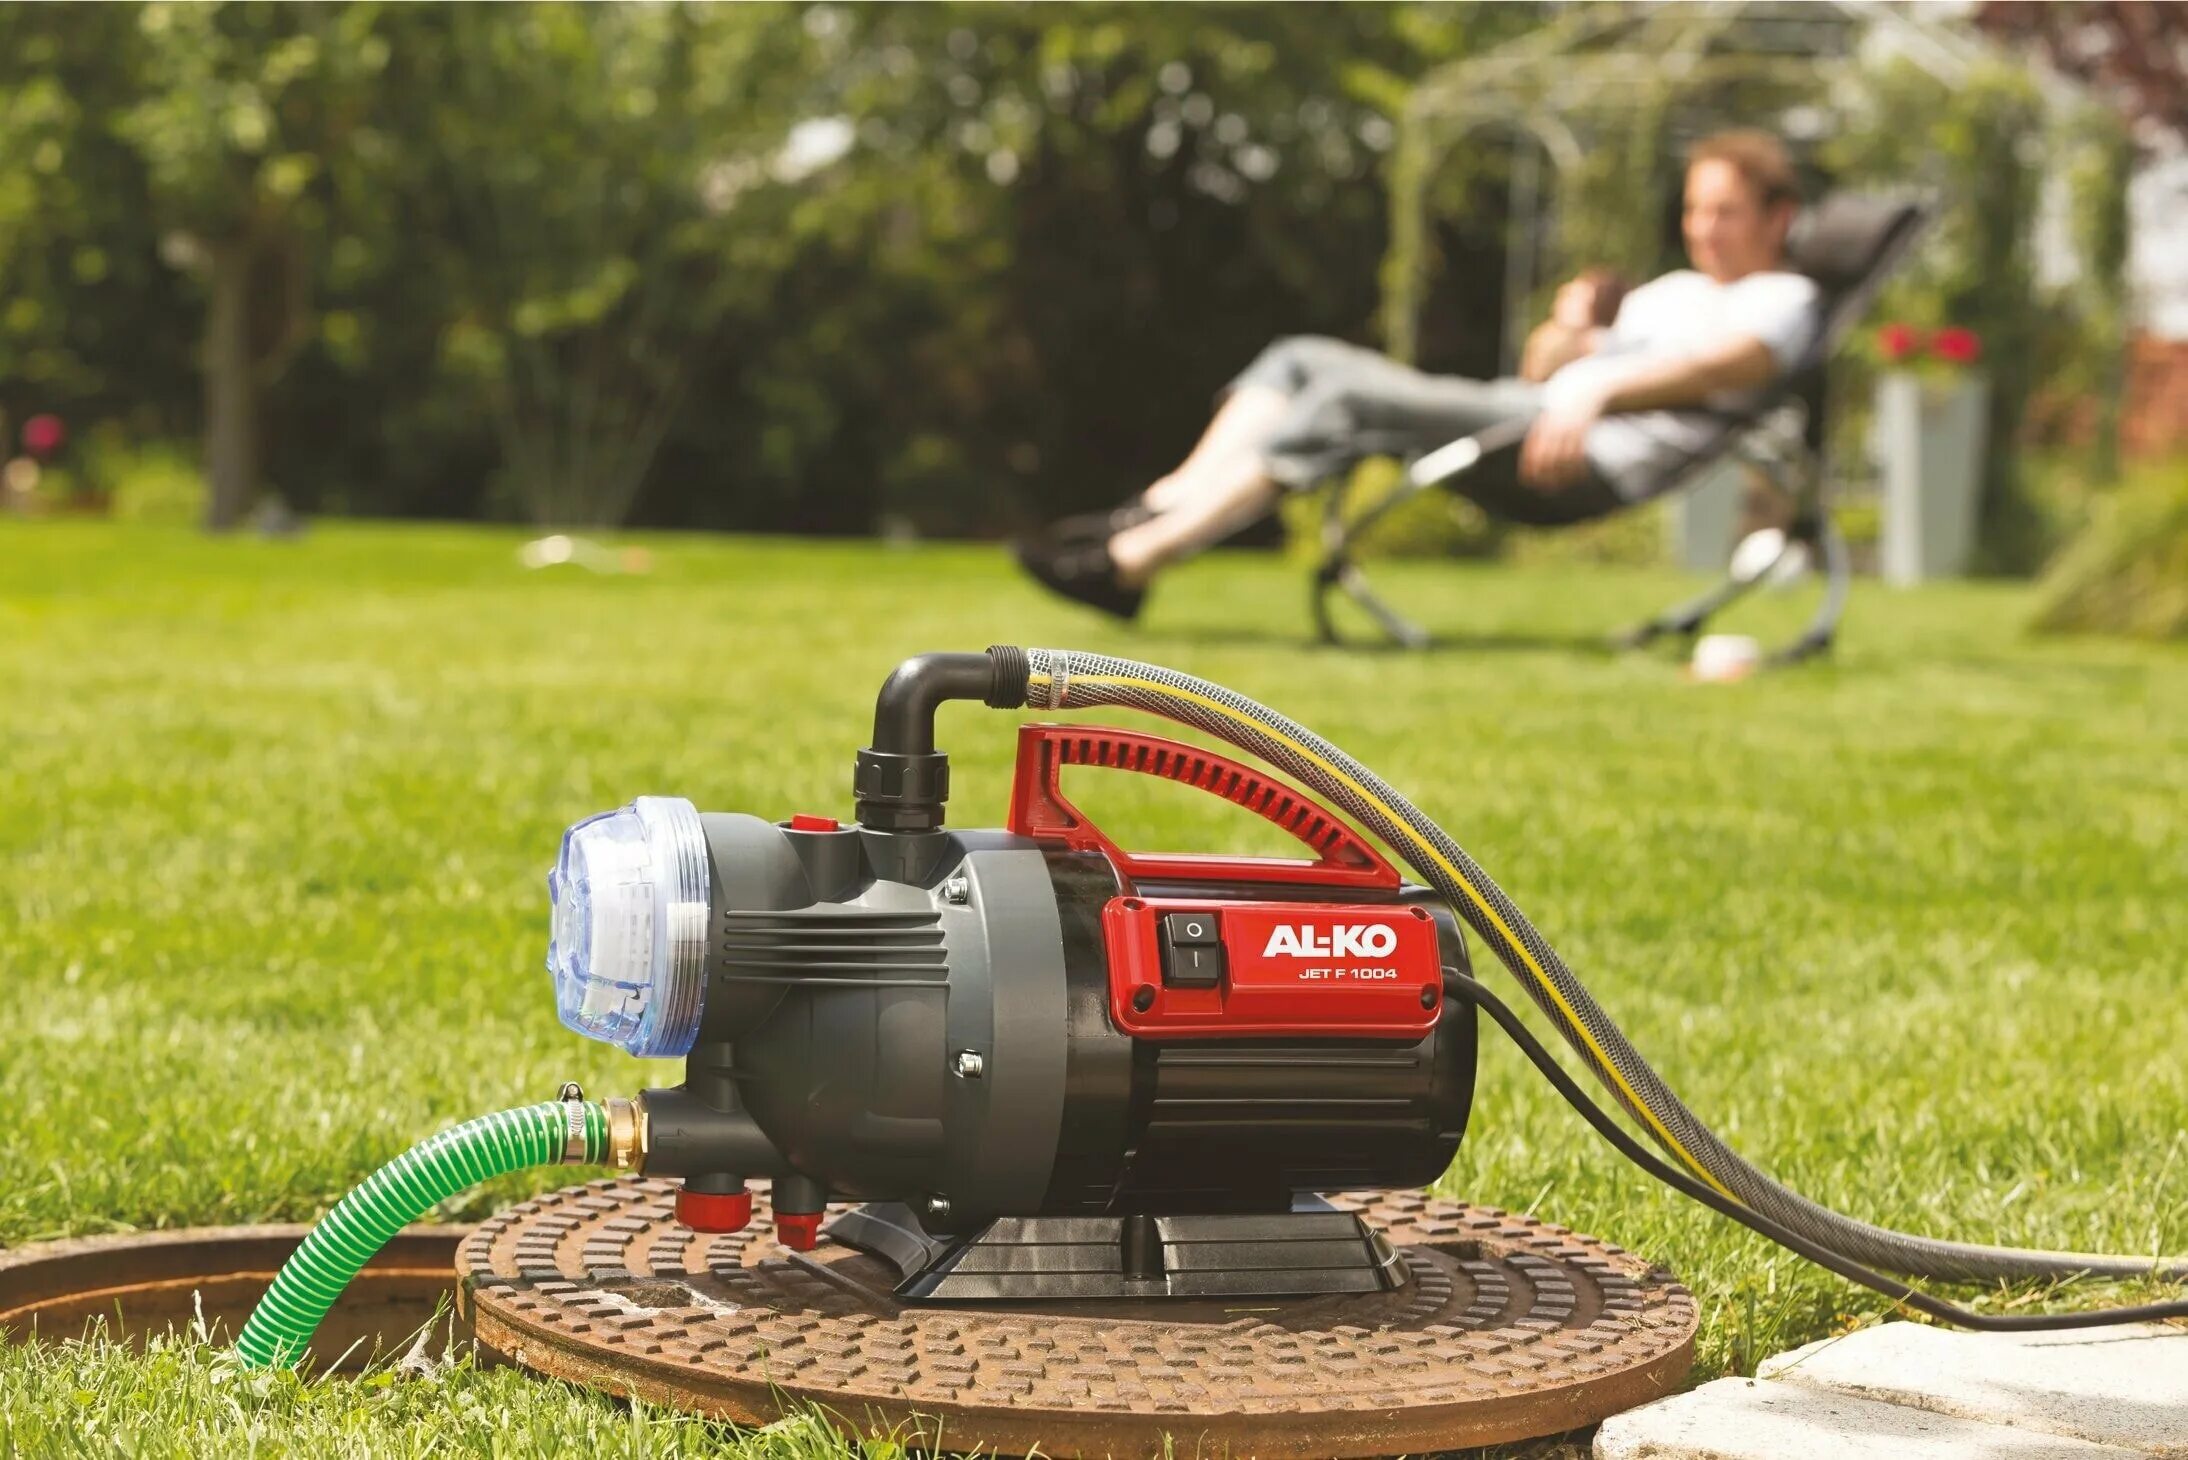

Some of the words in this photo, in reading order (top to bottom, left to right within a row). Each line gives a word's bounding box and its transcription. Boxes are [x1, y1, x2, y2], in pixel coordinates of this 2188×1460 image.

[1262, 924, 1398, 958] AL-KO
[1299, 968, 1332, 980] JET
[1335, 968, 1347, 980] F
[1350, 968, 1398, 980] 1004
